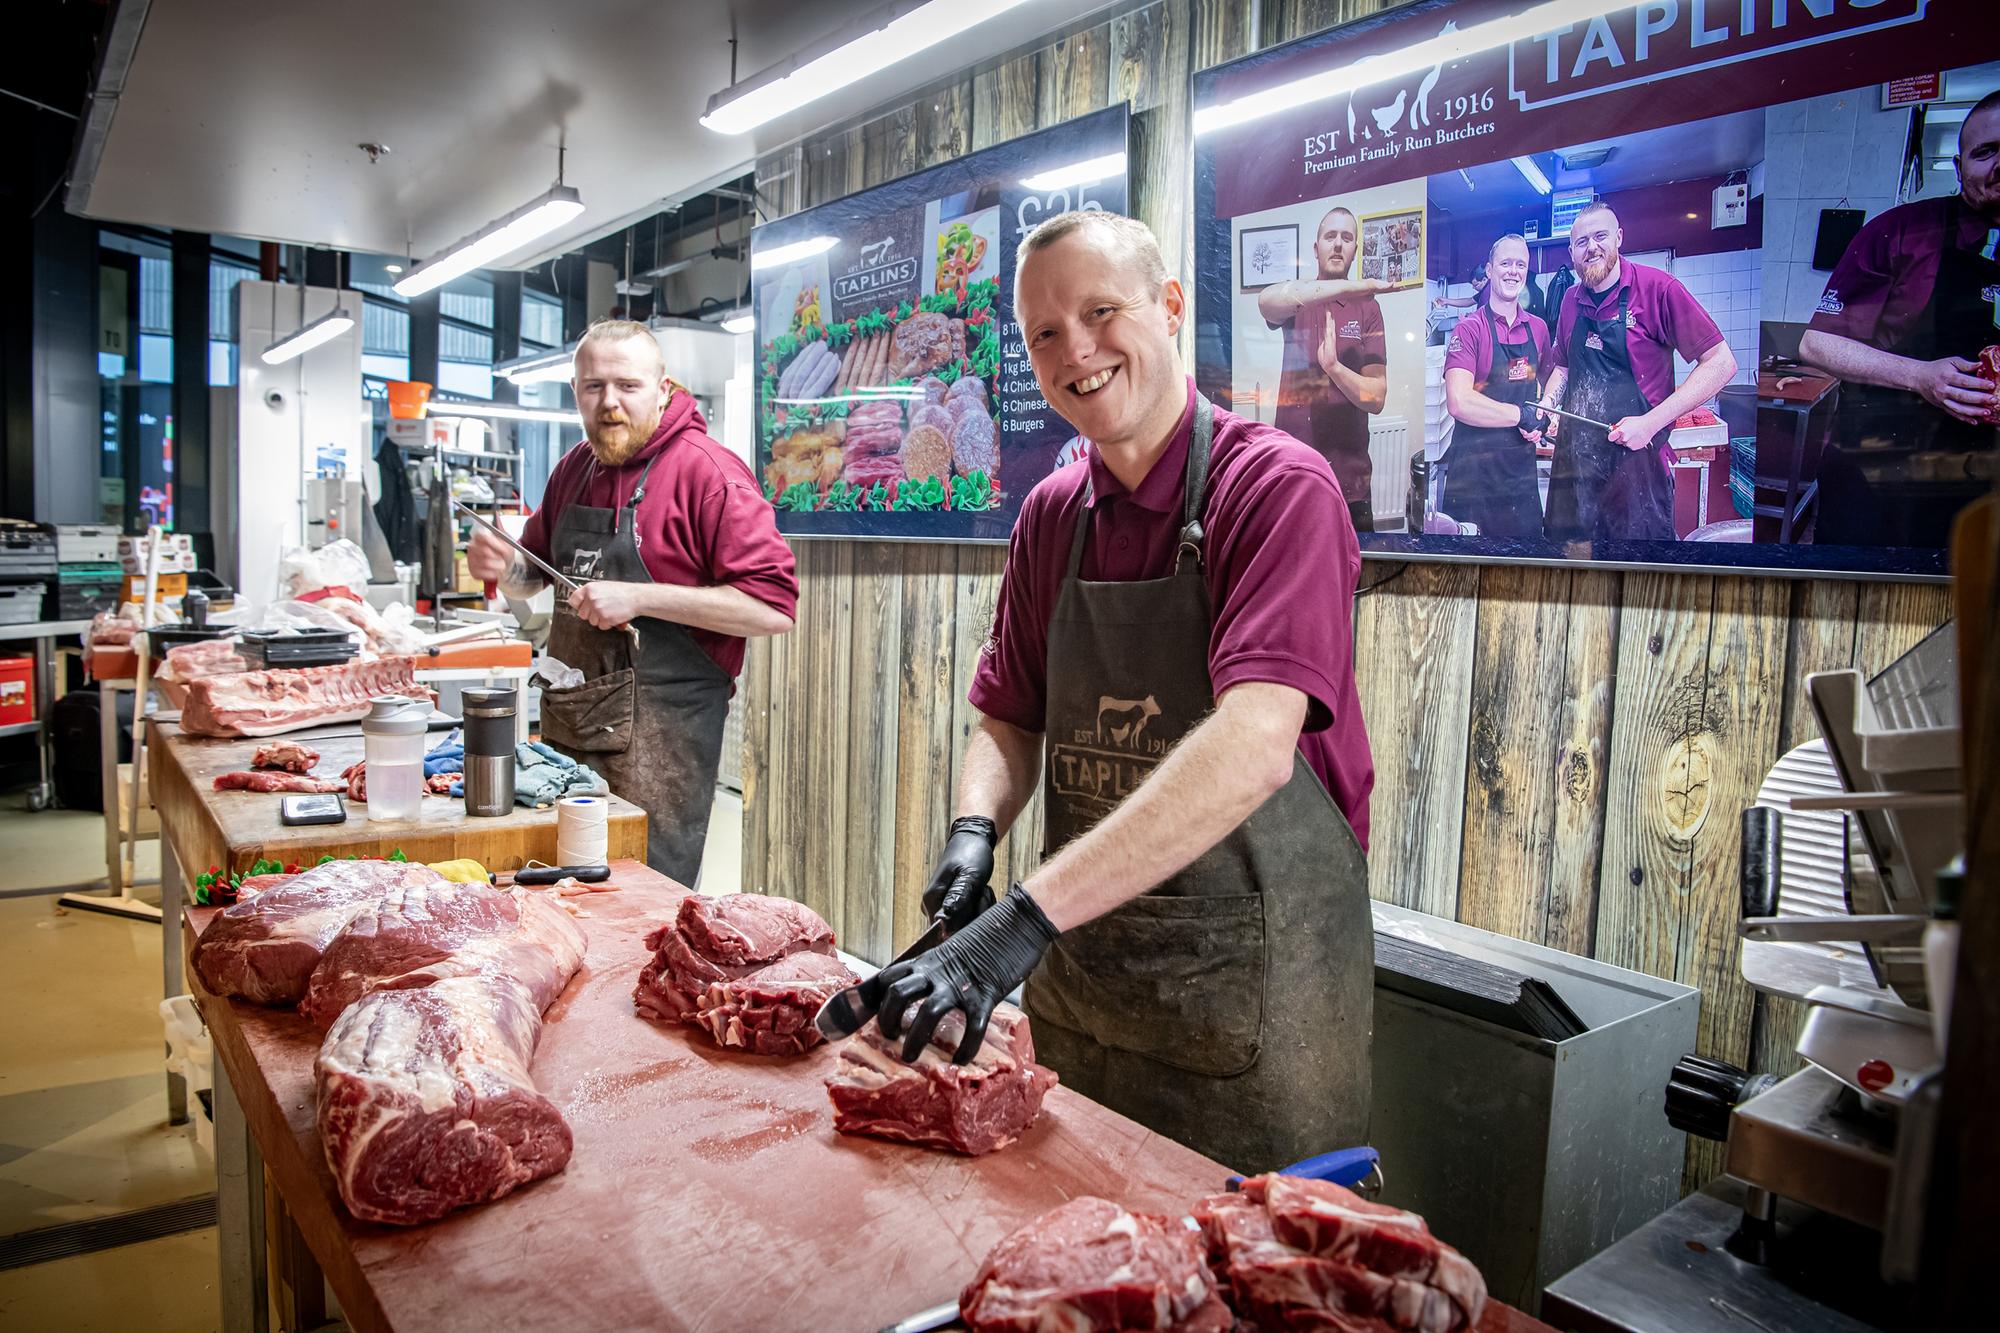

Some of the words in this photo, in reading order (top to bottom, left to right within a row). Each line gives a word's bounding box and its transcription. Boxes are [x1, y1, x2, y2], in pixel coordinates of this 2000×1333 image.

[1303, 130, 1340, 158] EST
[1443, 87, 1494, 121] 1916
[1304, 155, 1357, 175] Premium
[1360, 140, 1402, 162] Family
[1404, 136, 1432, 152] Run
[1435, 121, 1495, 145] Butchers
[839, 264, 909, 294] TAPLINS
[1002, 324, 1009, 336] 8
[1002, 343, 1009, 355] 4
[1003, 362, 1018, 376] 1kg
[1002, 382, 1009, 393] 4
[1002, 400, 1009, 413] 6
[1010, 399, 1047, 412] Chinese
[1002, 420, 1009, 432] 6
[1010, 419, 1045, 433] Burgers
[1074, 729, 1094, 744] EST
